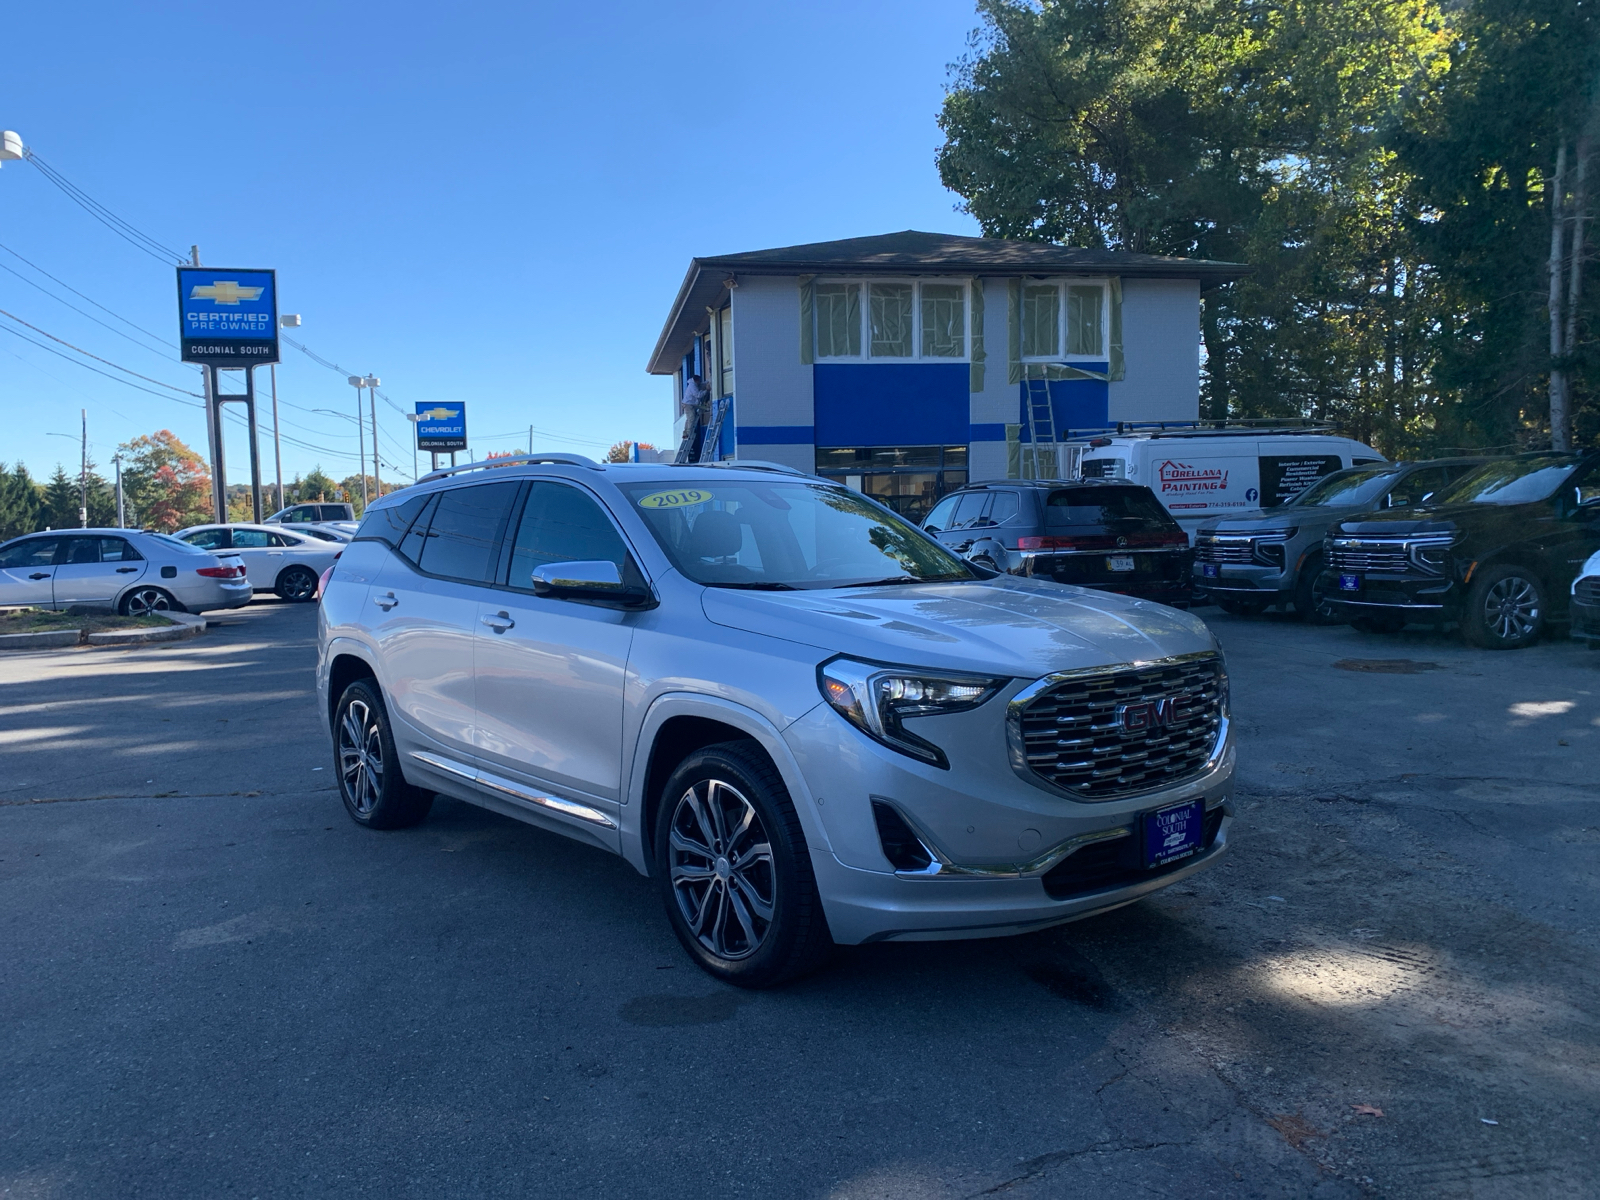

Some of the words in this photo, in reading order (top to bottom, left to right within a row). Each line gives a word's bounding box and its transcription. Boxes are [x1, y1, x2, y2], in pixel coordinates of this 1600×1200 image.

[187, 312, 269, 322] CERTIFIED
[192, 322, 266, 330] PRE-OWNED
[192, 346, 235, 354] COLONIAL
[1171, 469, 1222, 478] ORELLANA
[1162, 482, 1218, 492] PAINTING
[653, 491, 701, 506] 2019
[1118, 694, 1192, 732] GMC
[1157, 809, 1192, 827] COLONIAL
[1162, 820, 1186, 836] SOUTH
